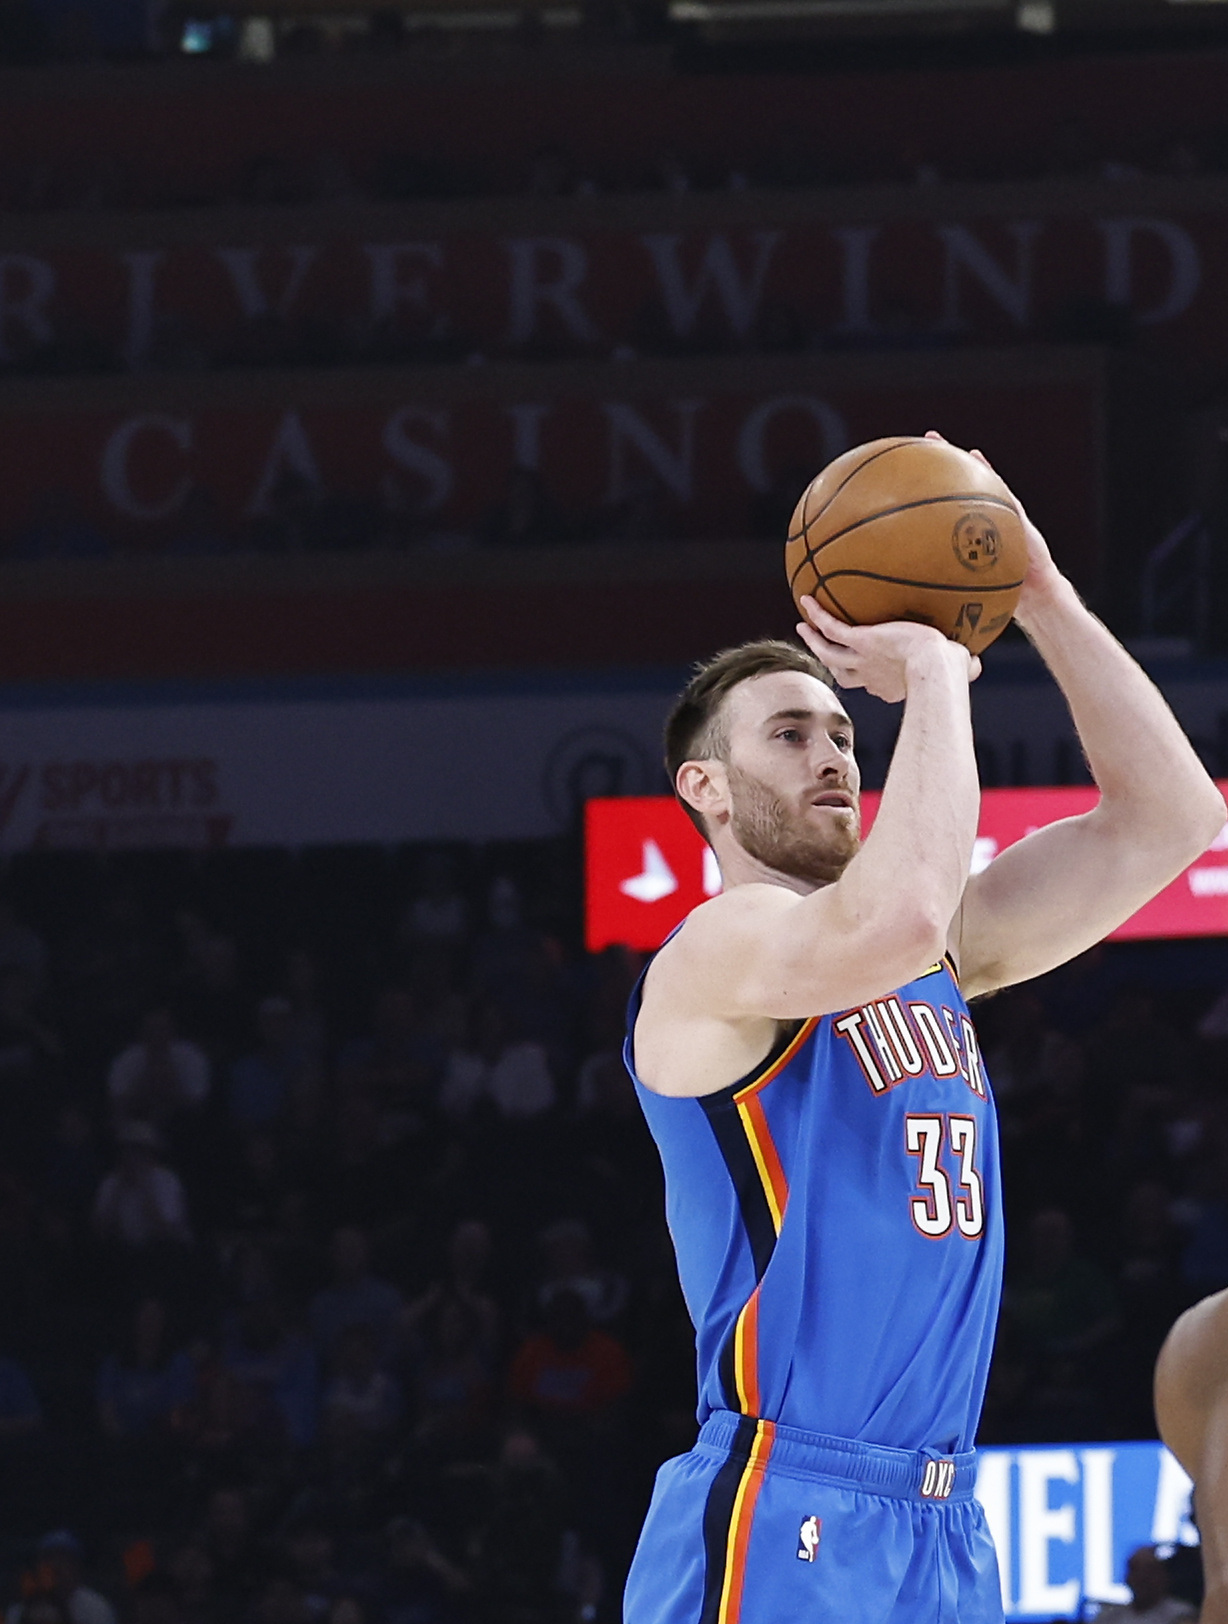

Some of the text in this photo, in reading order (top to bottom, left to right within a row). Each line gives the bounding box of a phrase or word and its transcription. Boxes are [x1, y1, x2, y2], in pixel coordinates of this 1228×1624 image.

[99, 393, 849, 520] CASINO
[42, 757, 220, 809] SPORTS
[905, 1112, 984, 1241] 33
[920, 1460, 956, 1499] OKC
